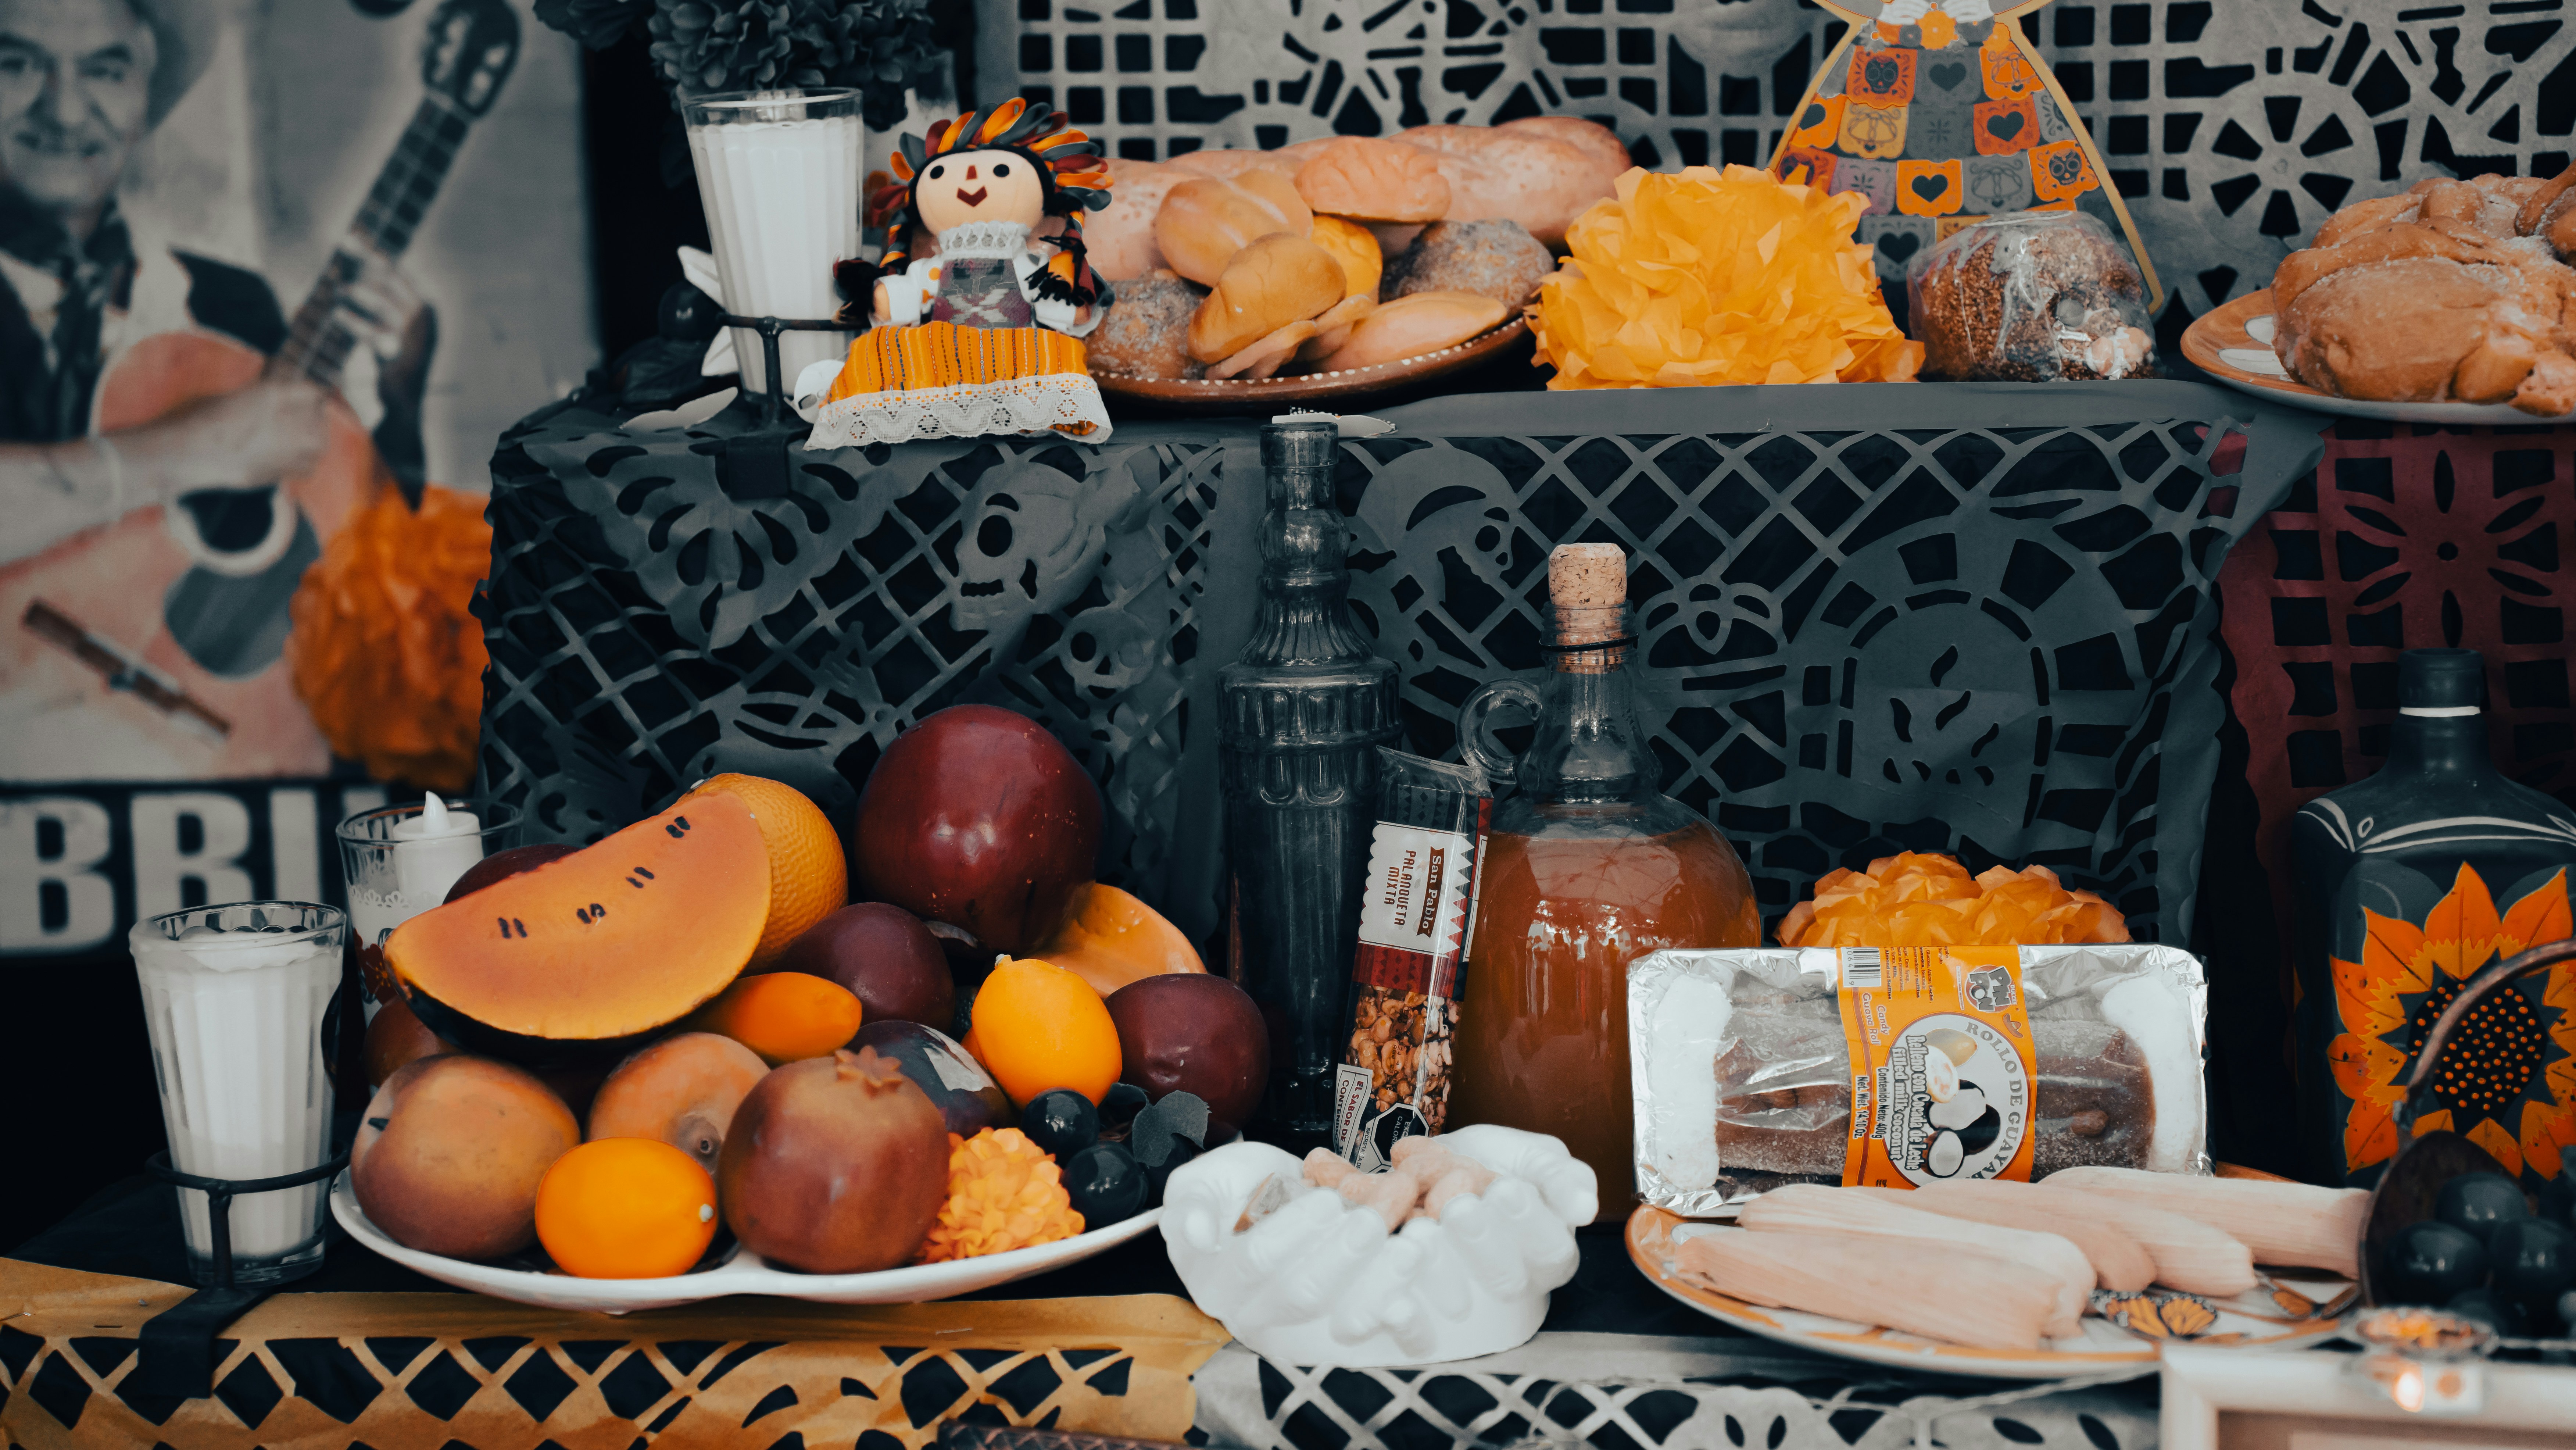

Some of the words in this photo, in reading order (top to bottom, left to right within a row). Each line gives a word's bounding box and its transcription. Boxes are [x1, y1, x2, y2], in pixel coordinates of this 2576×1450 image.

[0, 786, 386, 953] BRI
[1384, 866, 1399, 905] MIXTA
[1430, 856, 1441, 883] San
[1394, 850, 1416, 925] PALANQUETA
[1422, 889, 1438, 929] Pablo
[1969, 972, 1994, 1010] PON
[1989, 967, 2011, 1006] PIN
[1863, 993, 1873, 1025] Guava
[1869, 1028, 1881, 1045] Roll
[1877, 1005, 1889, 1035] Candy
[1891, 1047, 1909, 1080] filled
[1906, 1035, 1929, 1072] Relleno
[1965, 1022, 2017, 1074] ROLLO
[1355, 1081, 1364, 1092] EL
[1857, 1076, 1869, 1091] Net.
[1878, 1068, 1890, 1102] Contenido
[1894, 1081, 1909, 1112] milk
[1911, 1072, 1926, 1092] con
[2009, 1079, 2023, 1107] DE
[1335, 1079, 1349, 1140] CONTENIDO
[1344, 1093, 1359, 1126] SABOR
[1857, 1093, 1869, 1108] Wet.
[1877, 1105, 1889, 1121] Neto:
[1908, 1093, 1931, 1128] Cocada
[1340, 1128, 1348, 1142] DE
[1854, 1129, 1865, 1139] Oz.
[1856, 1110, 1868, 1127] 14.10
[1871, 1123, 1887, 1139] 400g
[1889, 1112, 1904, 1160] coconut
[1908, 1129, 1928, 1143] de
[1965, 1111, 2021, 1179] GUAYAB
[1905, 1143, 1928, 1170] Leche
